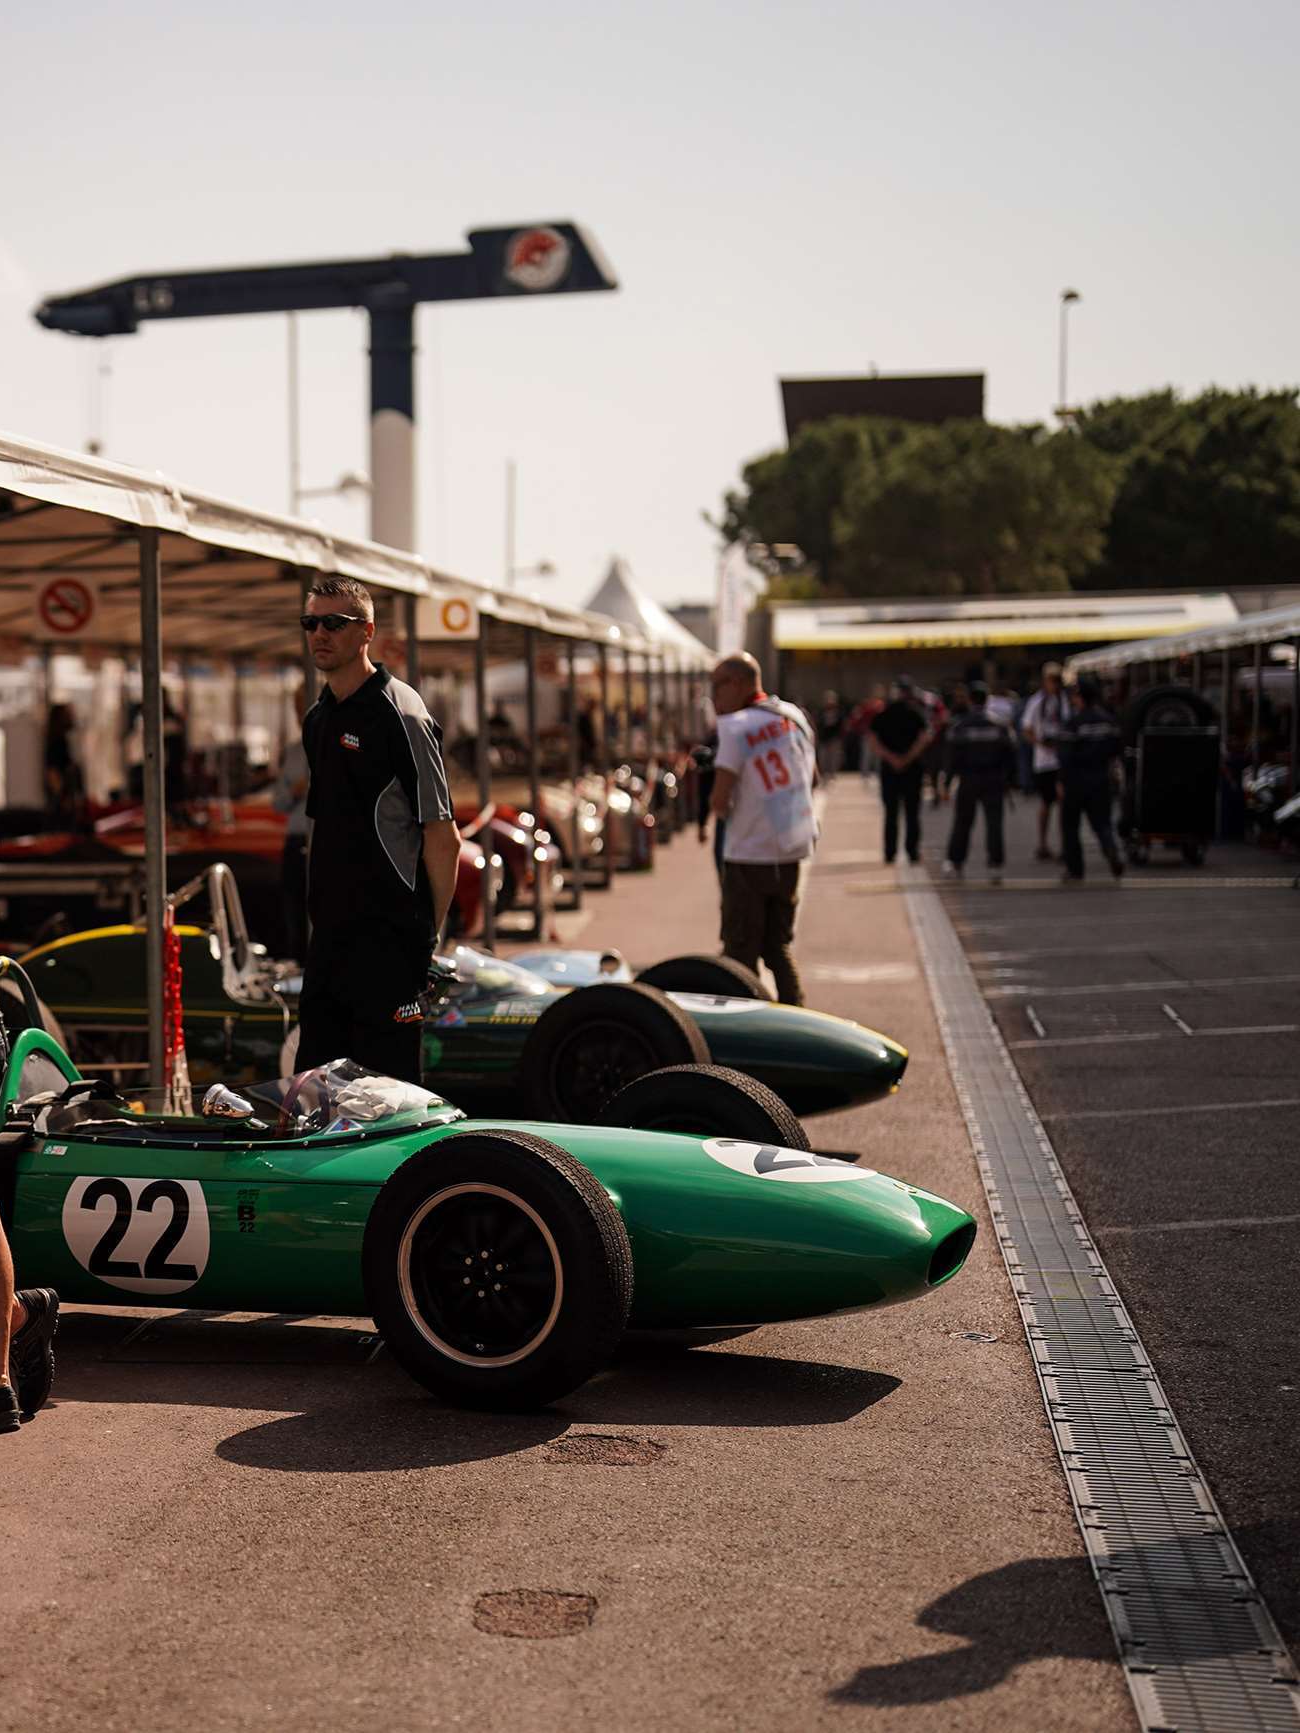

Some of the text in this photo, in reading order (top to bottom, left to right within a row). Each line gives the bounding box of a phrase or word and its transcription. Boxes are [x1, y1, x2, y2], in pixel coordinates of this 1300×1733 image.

[754, 748, 791, 794] 13
[237, 1205, 257, 1221] B
[239, 1221, 257, 1233] 22
[80, 1178, 198, 1281] 22
